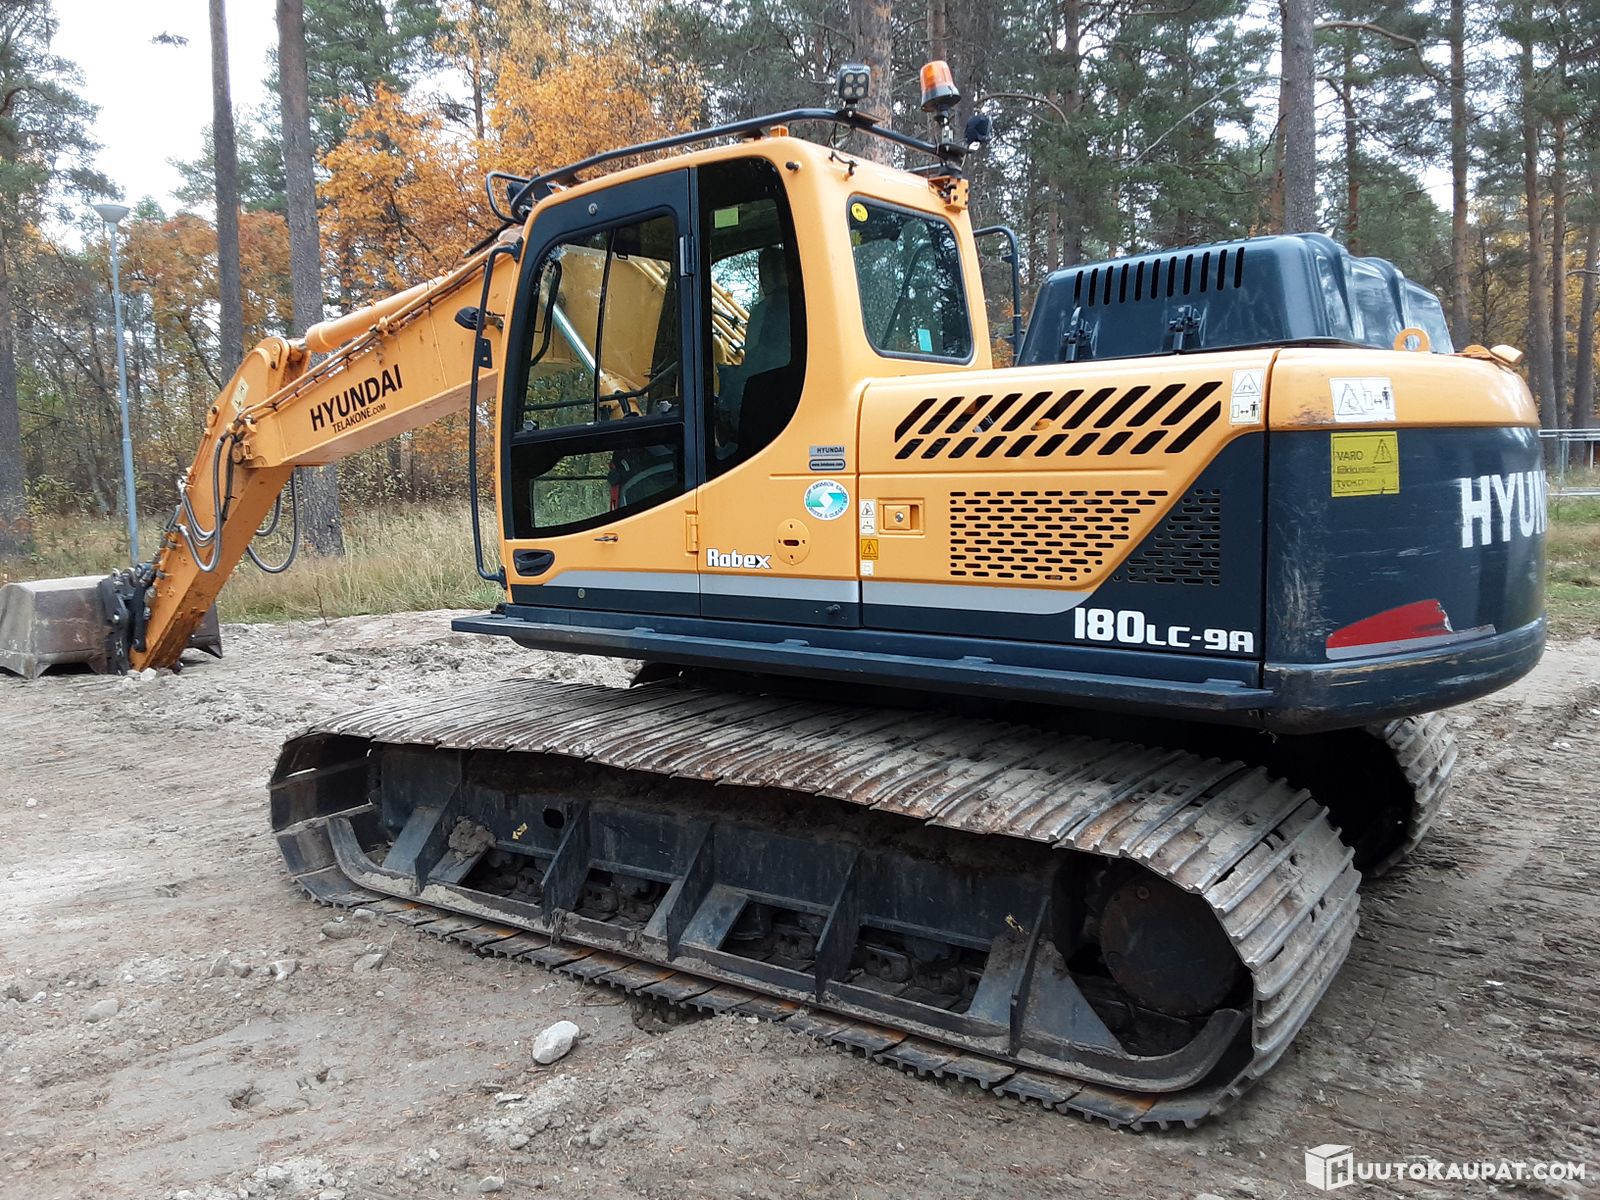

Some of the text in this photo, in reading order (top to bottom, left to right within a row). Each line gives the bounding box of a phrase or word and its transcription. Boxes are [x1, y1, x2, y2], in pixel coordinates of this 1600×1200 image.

[310, 363, 403, 432] HYUNDAI
[816, 446, 845, 454] HYUNDAI
[1335, 450, 1364, 461] VARO
[706, 547, 772, 569] Robex
